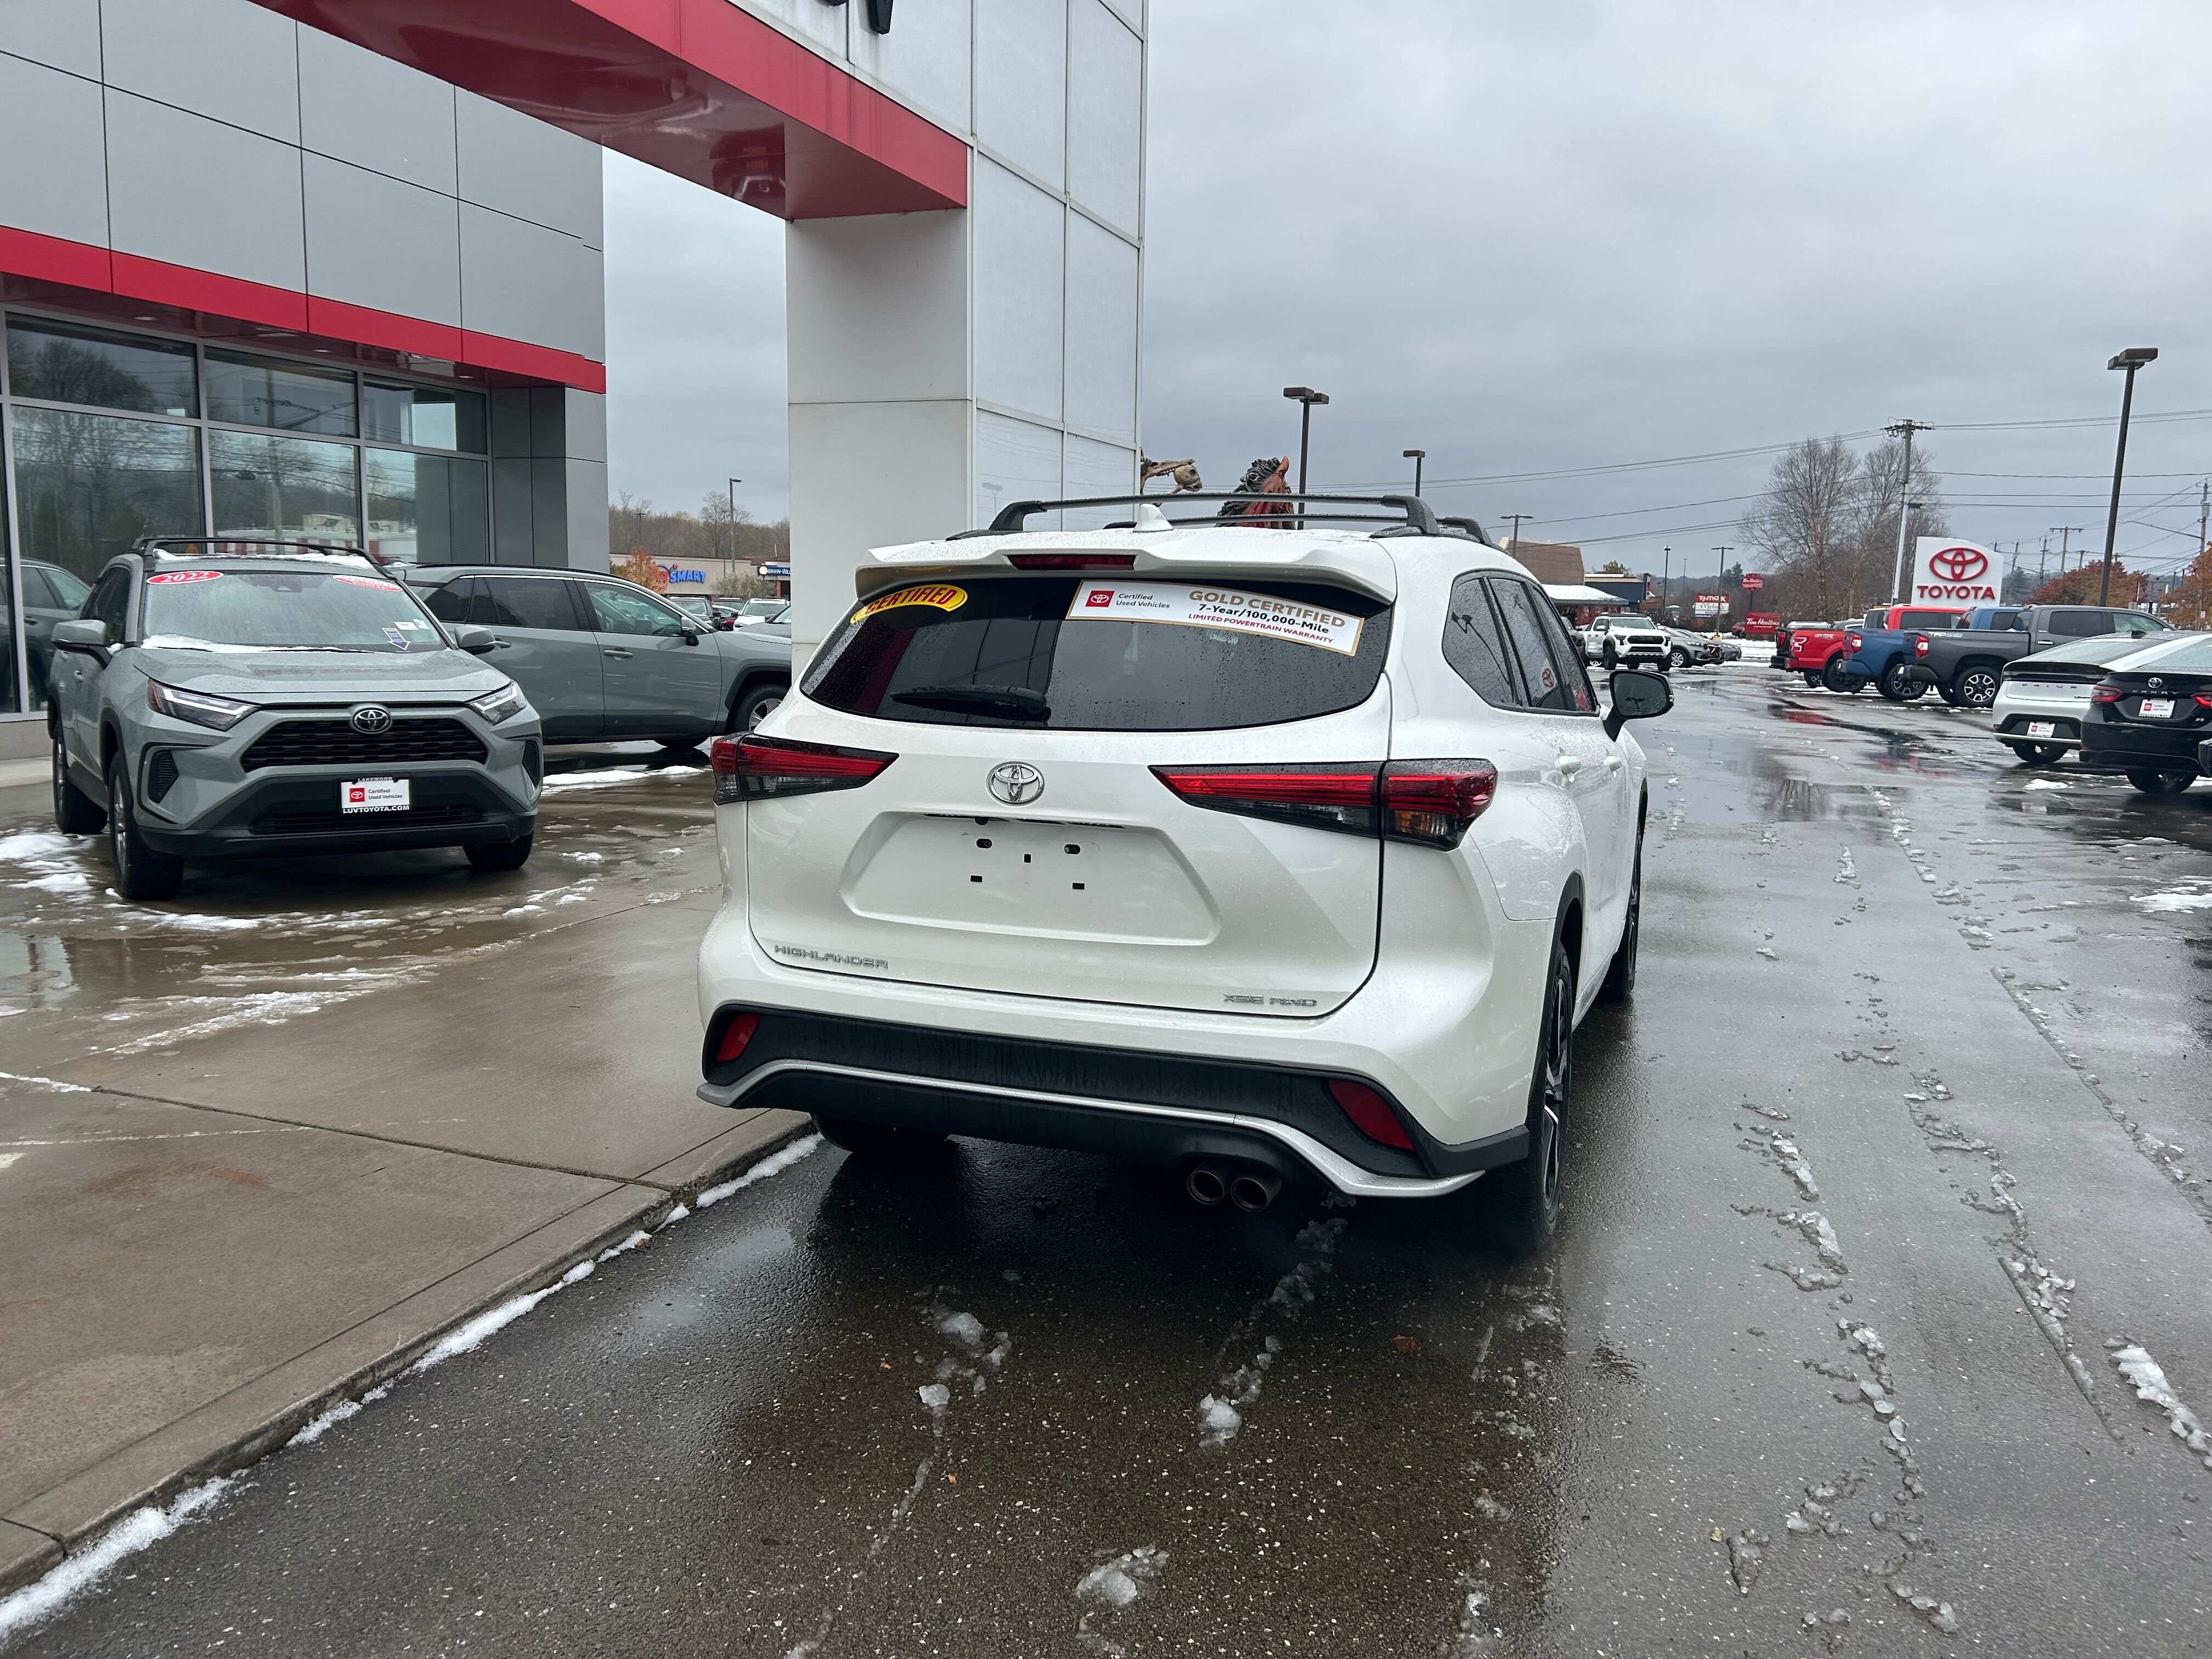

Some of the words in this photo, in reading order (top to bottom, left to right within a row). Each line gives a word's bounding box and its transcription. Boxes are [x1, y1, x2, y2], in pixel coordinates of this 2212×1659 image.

[160, 572, 210, 583] 2022
[864, 587, 957, 614] CERTIFIED
[1917, 585, 1995, 600] TOYOTA
[1189, 590, 1244, 606] GOLD
[1248, 599, 1345, 627] CERTIFIED
[1198, 604, 1329, 634] 7-Year/100,000-Mile
[1188, 613, 1223, 622] LIMITED
[1224, 618, 1282, 632] POWERTRAIN
[1283, 628, 1334, 644] WARRANTY
[343, 805, 409, 814] LUVTOYOTA.COM
[774, 944, 889, 969] HIGHLANDER
[1223, 992, 1264, 1005] XSE
[1269, 996, 1317, 1006] AWD
